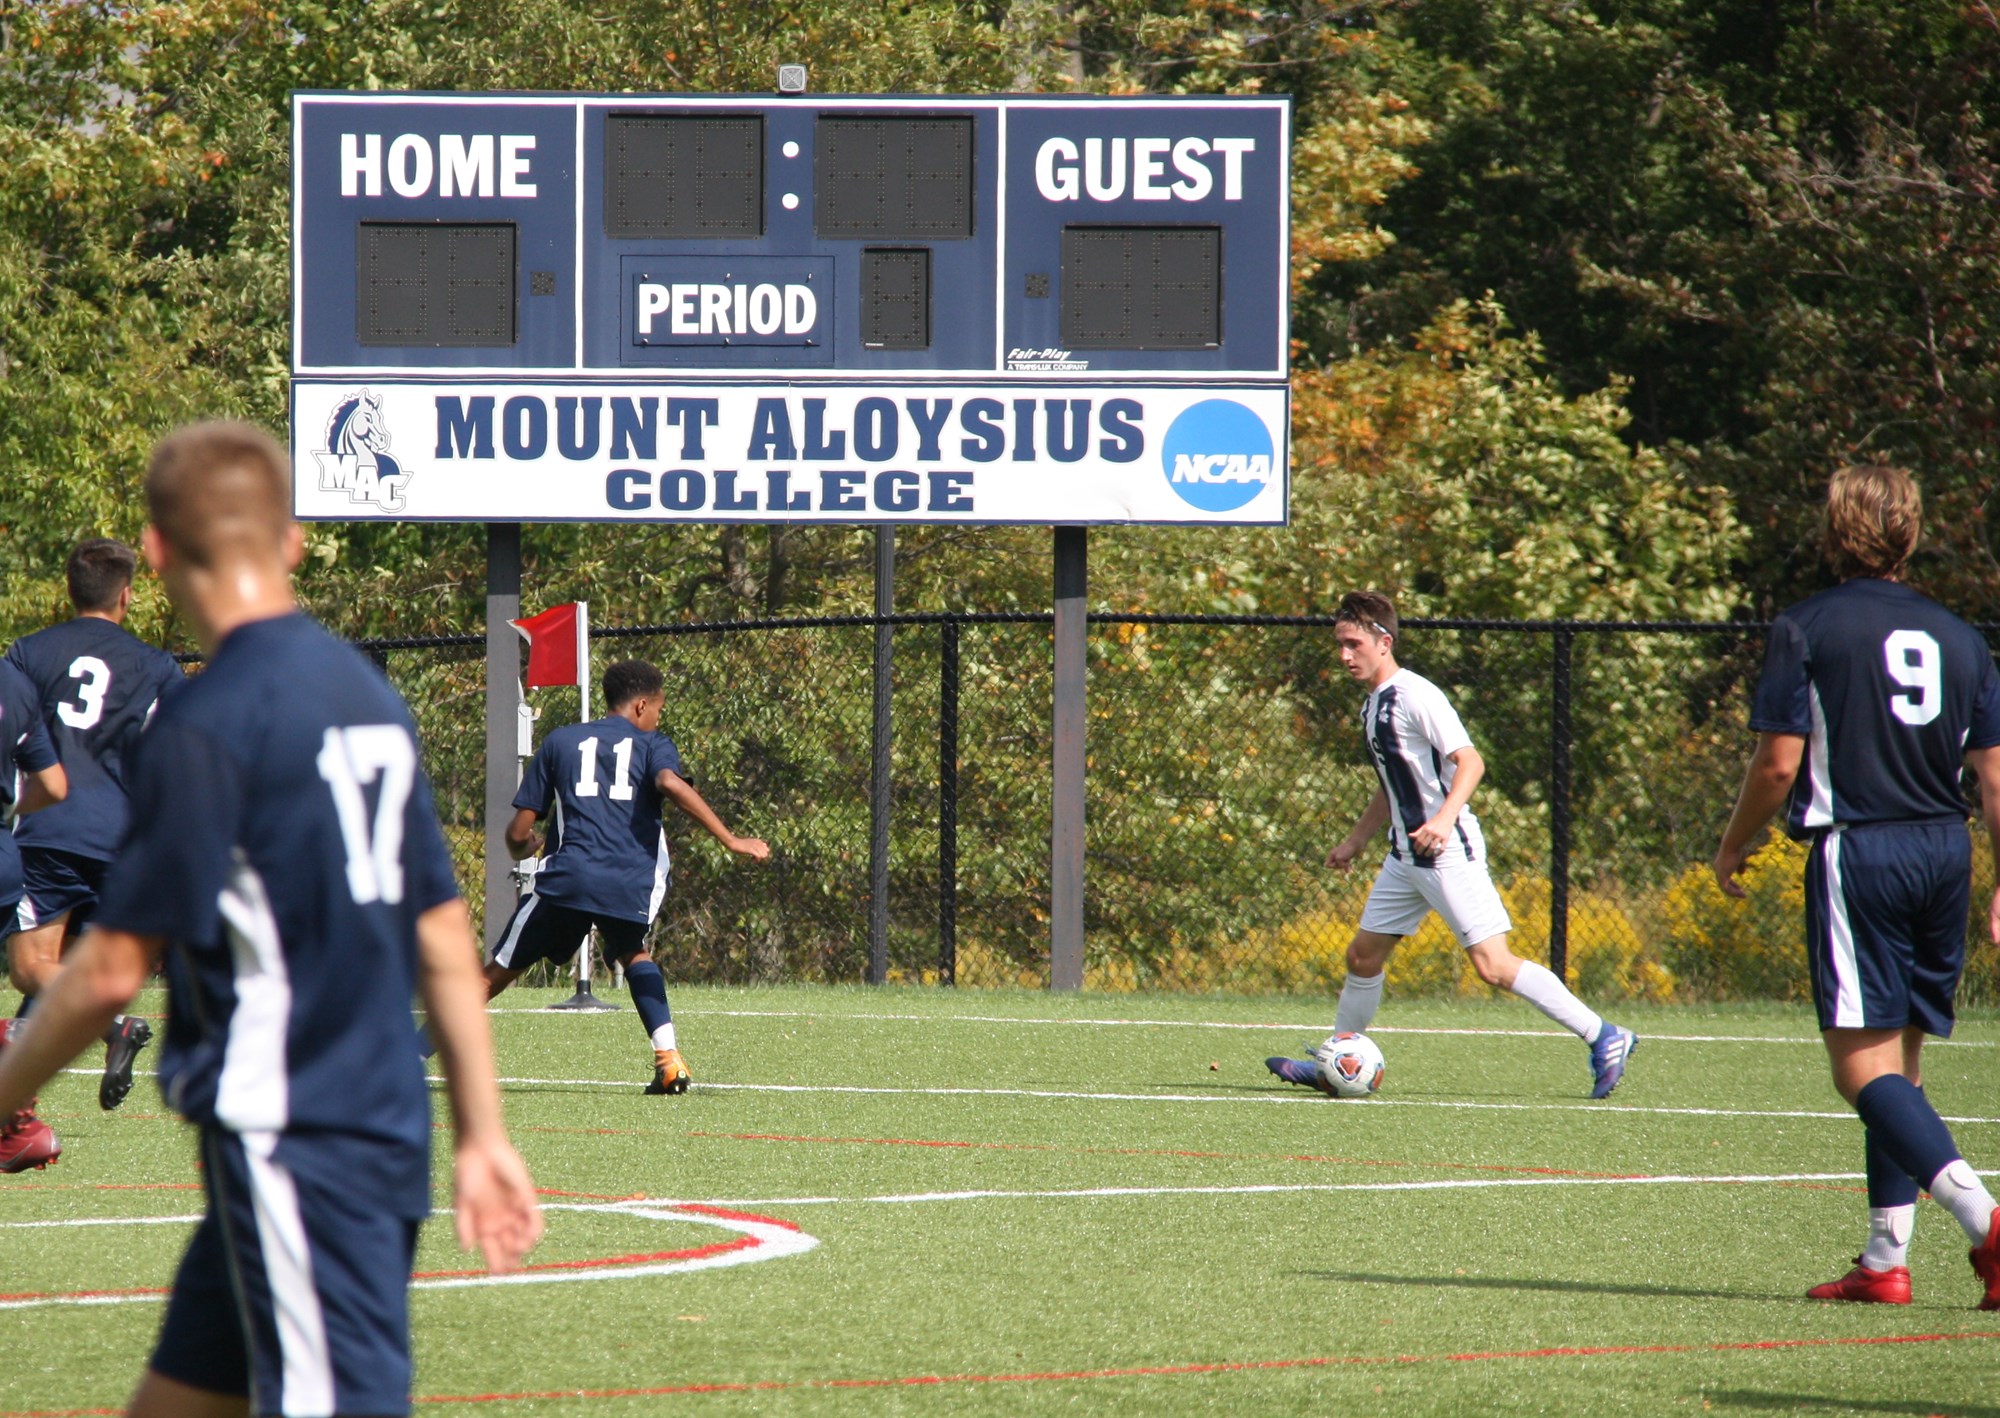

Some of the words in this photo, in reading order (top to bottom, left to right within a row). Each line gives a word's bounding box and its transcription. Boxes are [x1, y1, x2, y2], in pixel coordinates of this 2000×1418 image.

[341, 133, 537, 198] HOME
[1035, 137, 1256, 202] GUEST
[638, 283, 817, 335] PERIOD
[1007, 348, 1072, 361] Fair-Play
[434, 394, 720, 462] MOUNT
[746, 396, 1145, 464] ALOYSIUS
[314, 452, 411, 511] MAC
[605, 468, 975, 512] COLLEGE
[1172, 453, 1271, 484] NCAA
[57, 655, 111, 730] 3
[1884, 629, 1942, 727] 9
[575, 736, 633, 801] 11
[317, 724, 416, 904] 17
